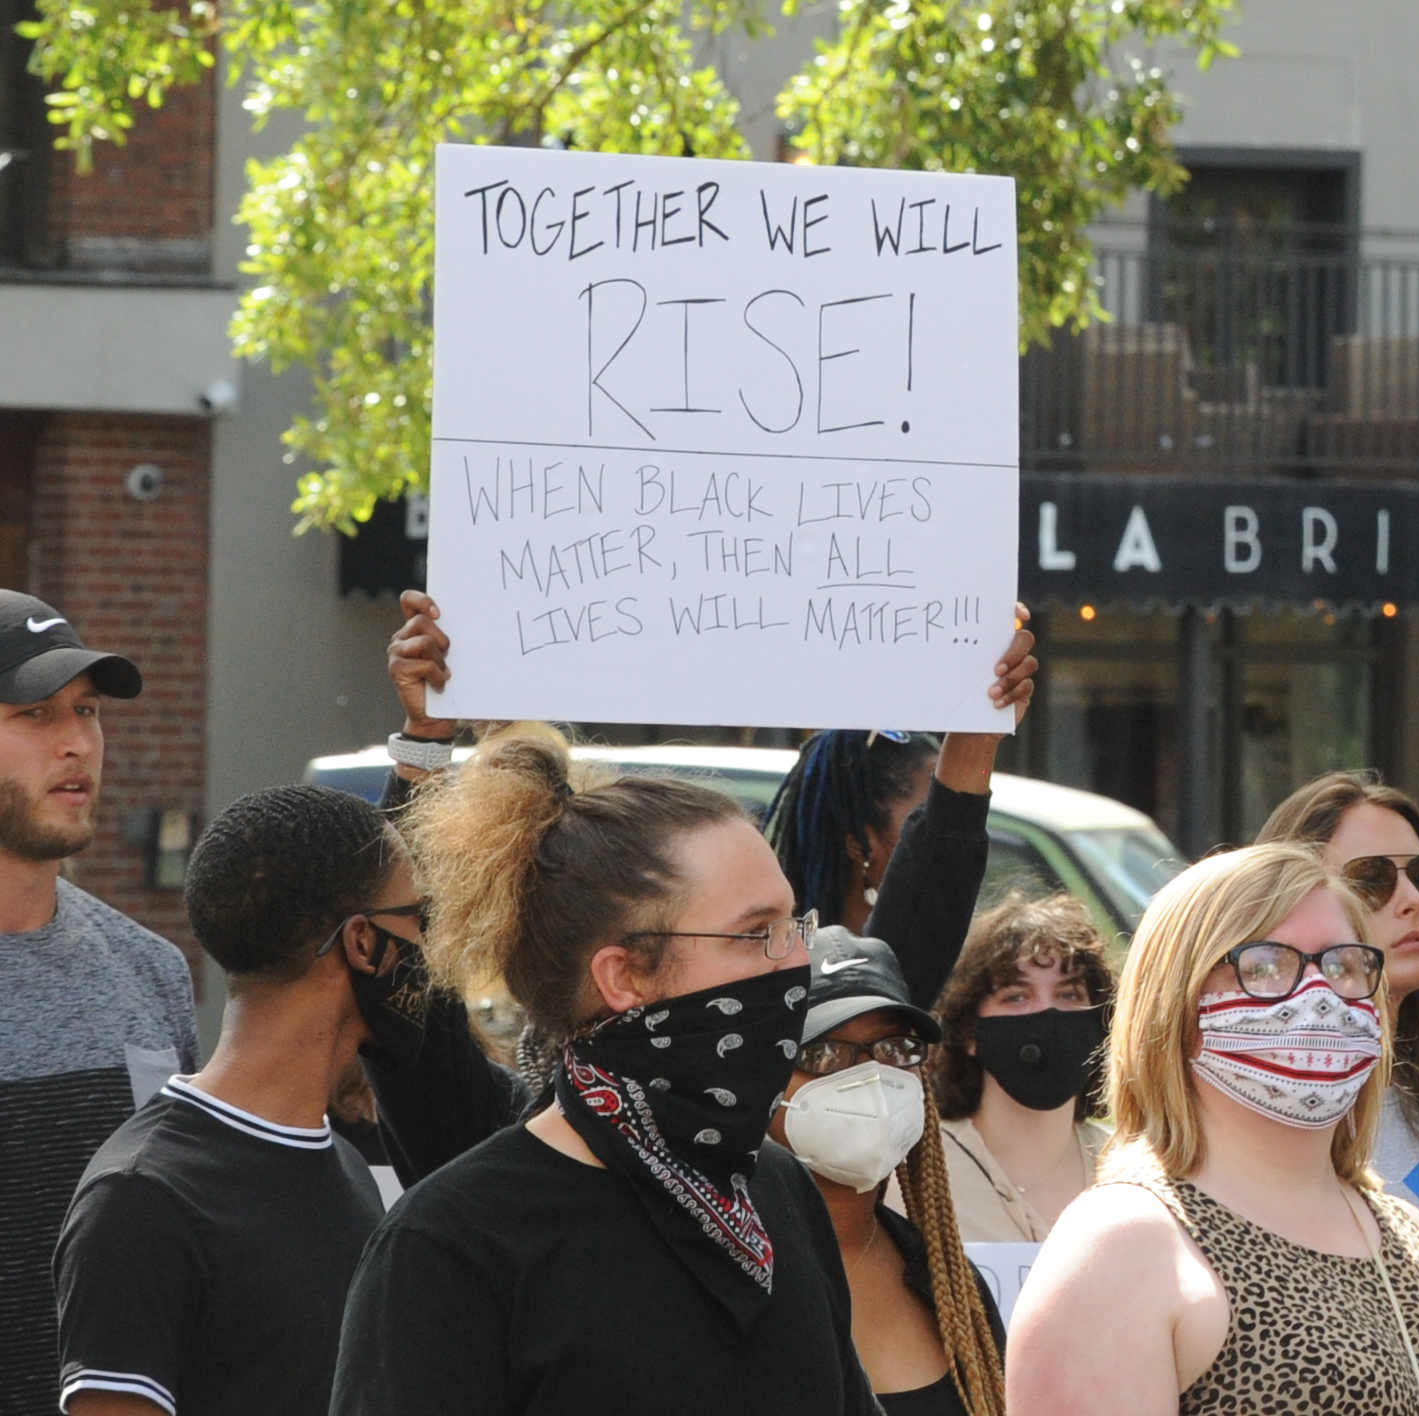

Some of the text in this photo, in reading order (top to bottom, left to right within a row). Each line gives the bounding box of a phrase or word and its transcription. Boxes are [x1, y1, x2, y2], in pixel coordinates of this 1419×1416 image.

[464, 179, 1002, 261] TOGETHER WE WILL
[578, 278, 915, 440] RISE!
[464, 456, 604, 525] WHEN
[635, 465, 772, 522] BLACK
[798, 477, 931, 526] LIVES
[501, 525, 913, 597] MATTER, THEN ALL
[517, 594, 979, 656] LIVES WILL MATTER!!!
